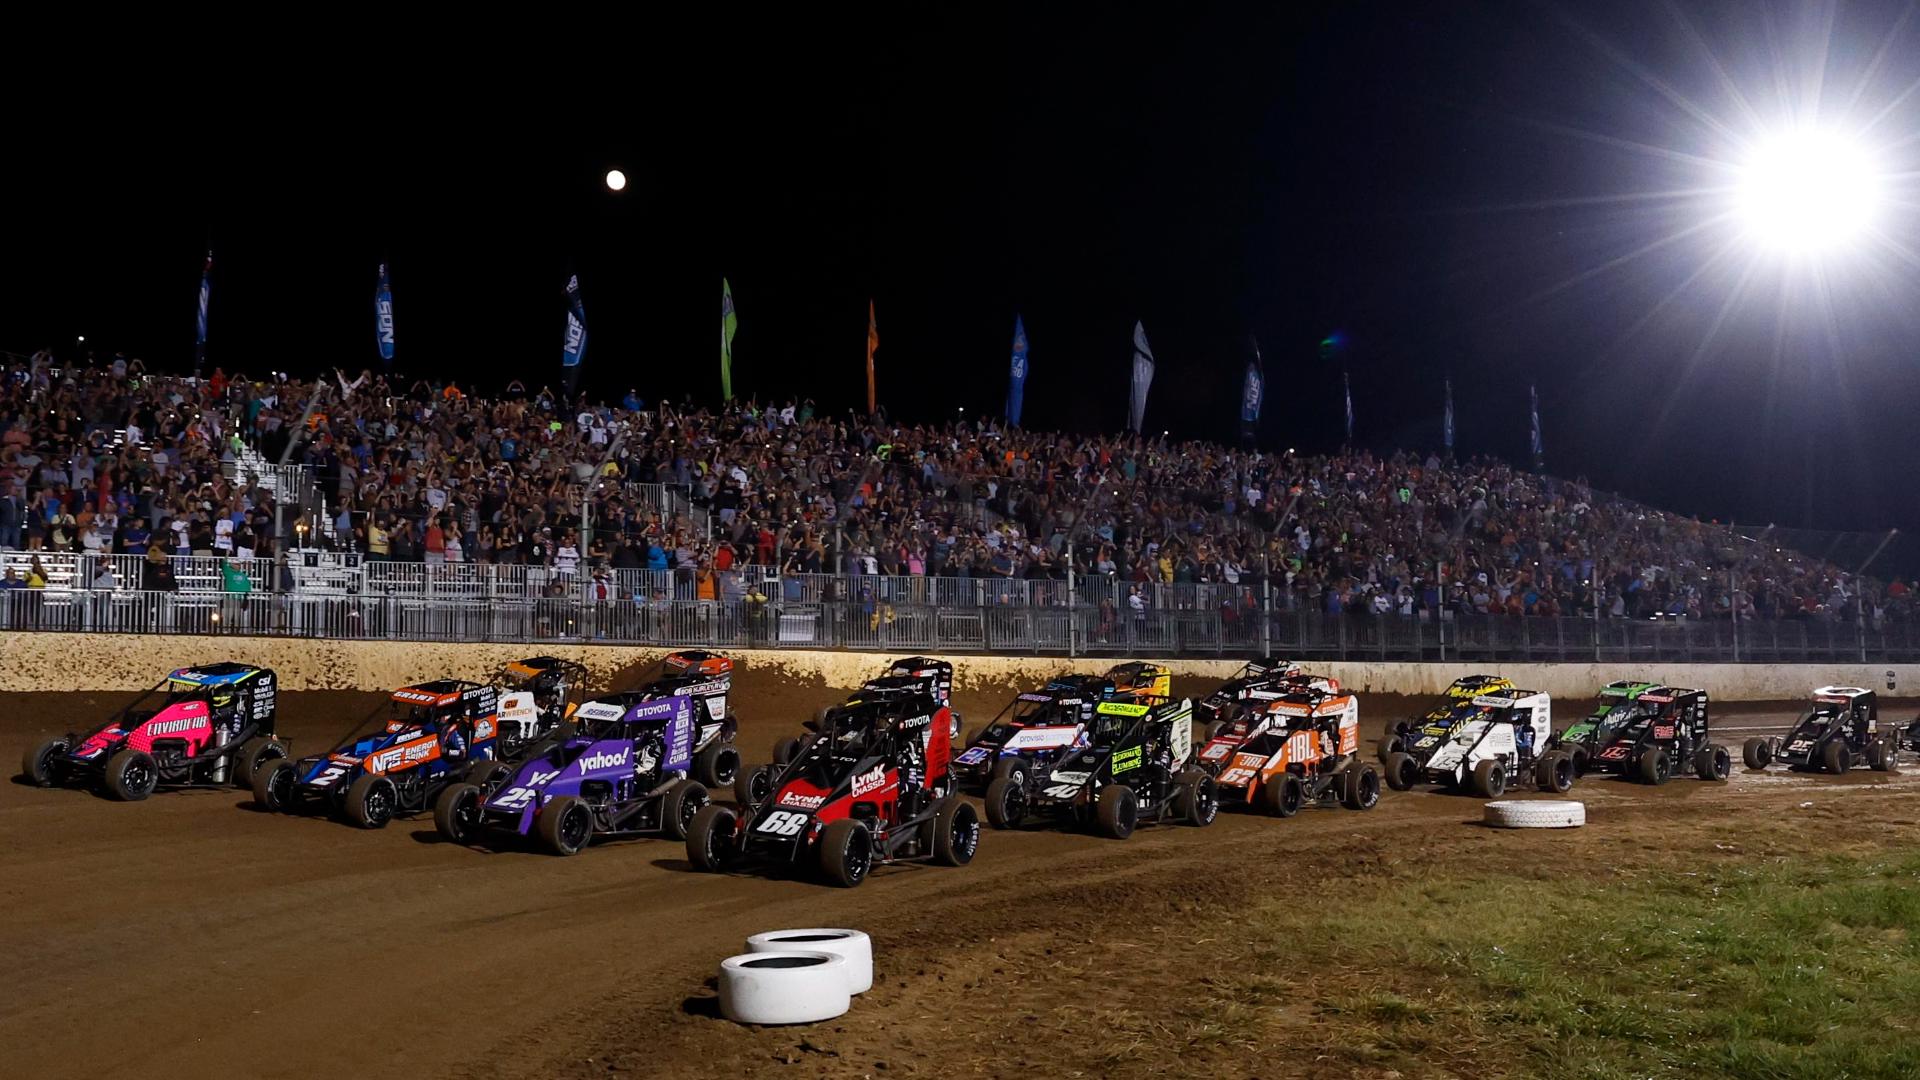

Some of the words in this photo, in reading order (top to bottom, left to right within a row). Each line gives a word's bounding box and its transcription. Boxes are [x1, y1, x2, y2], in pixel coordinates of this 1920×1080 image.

[380, 300, 394, 344] NOS
[393, 691, 436, 702] GRANT
[469, 685, 493, 698] TOYOTA
[1062, 698, 1083, 706] TOYOTA
[497, 708, 533, 719] ARWRENCH
[584, 708, 618, 718] REIMER
[643, 703, 672, 717] TOYOTA
[904, 714, 931, 729] TOYOTA
[405, 739, 438, 756] ENERGY
[1287, 732, 1315, 763] JBL
[404, 749, 430, 761] DRINK
[579, 747, 630, 776] yahoo!
[669, 751, 688, 765] CURB
[1239, 756, 1263, 768] JBL
[1112, 756, 1142, 773] PLUMBING
[851, 777, 886, 798] CHASSIS
